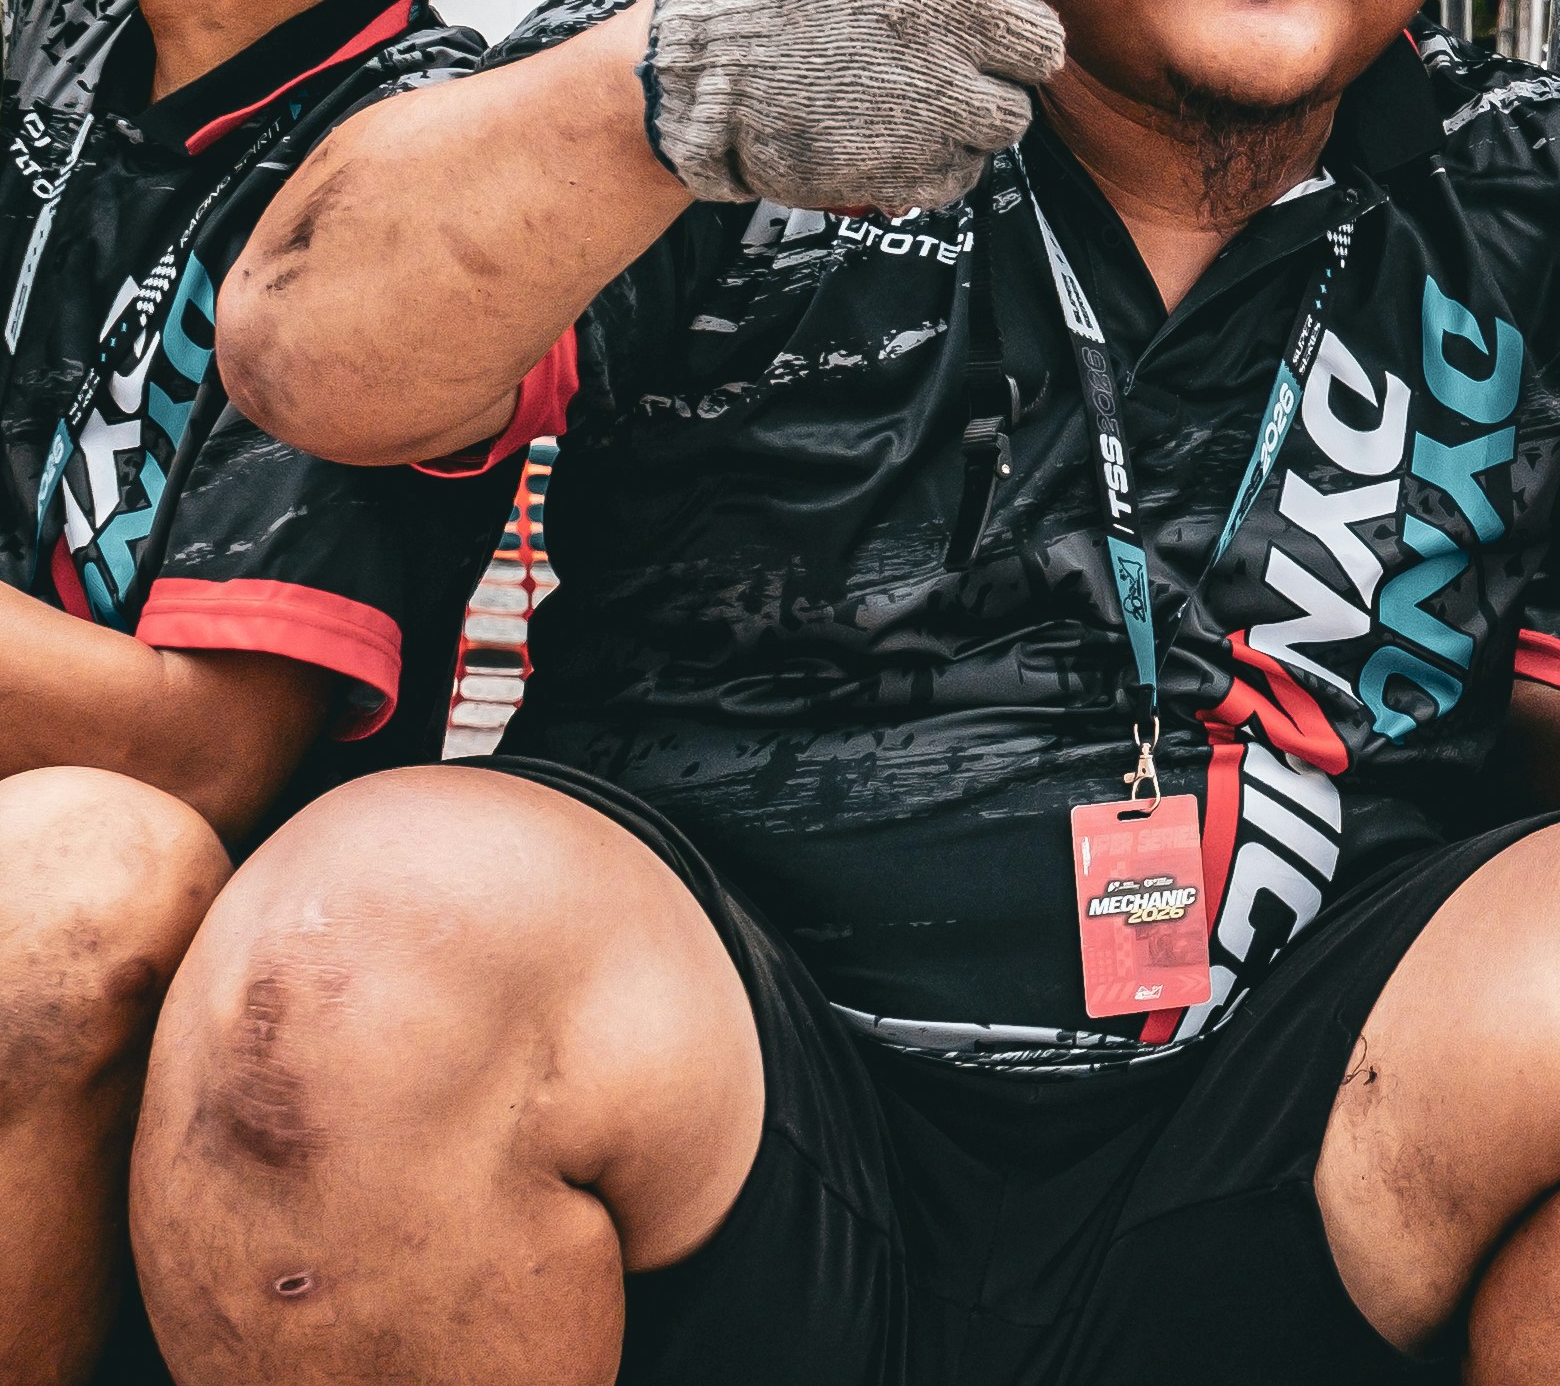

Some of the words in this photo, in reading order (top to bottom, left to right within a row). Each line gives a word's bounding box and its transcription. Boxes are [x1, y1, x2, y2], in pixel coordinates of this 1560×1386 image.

[1291, 314, 1312, 363] SUPER
[1297, 322, 1322, 375] SERIES
[1359, 273, 1524, 747] DYNO
[1089, 887, 1197, 916] MECHANIC
[1128, 906, 1185, 925] 2026
